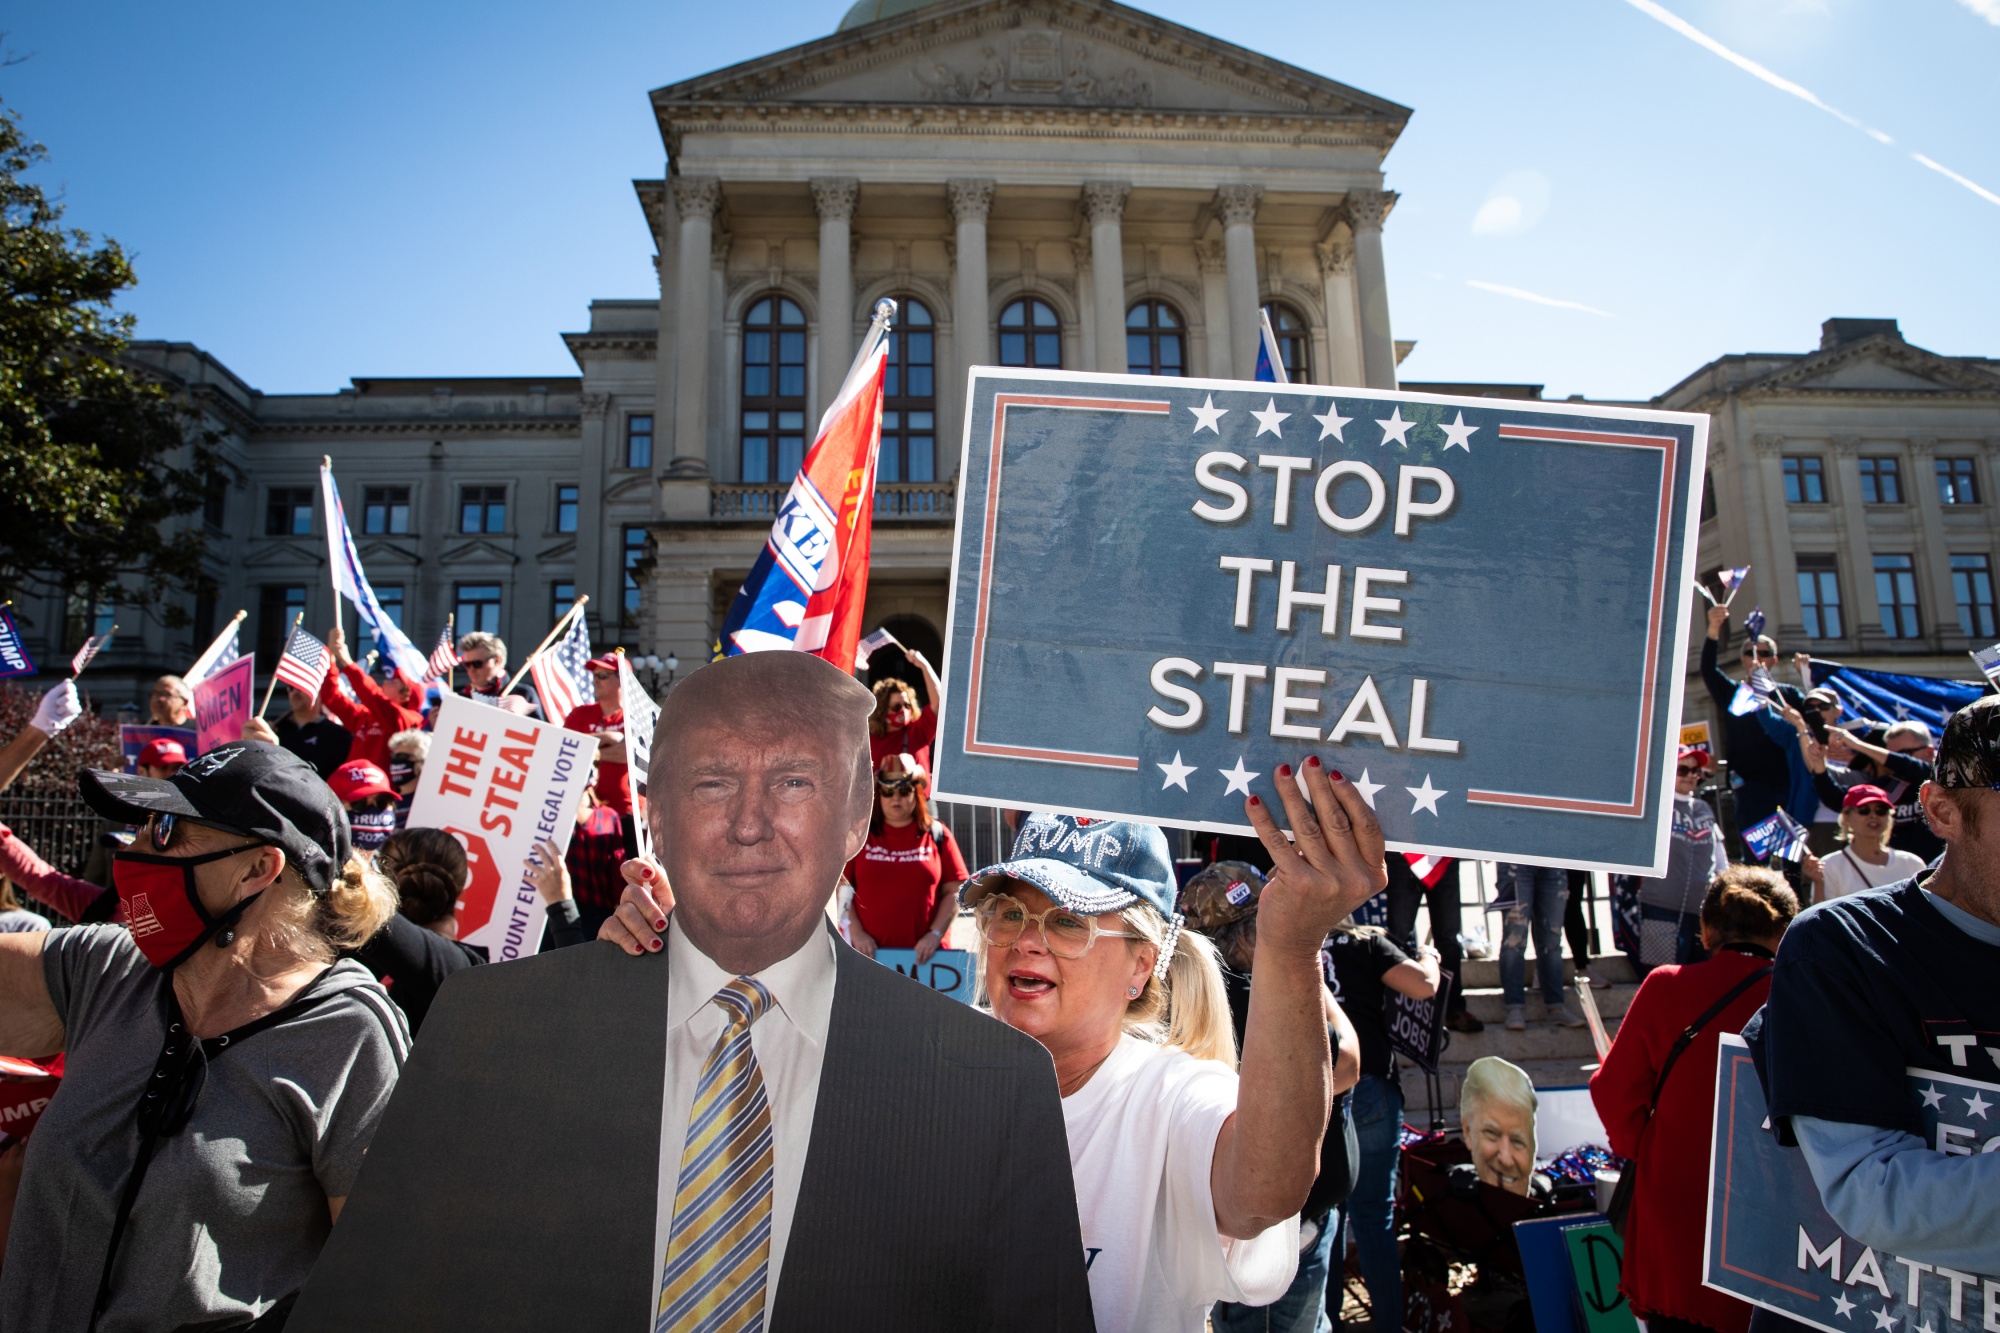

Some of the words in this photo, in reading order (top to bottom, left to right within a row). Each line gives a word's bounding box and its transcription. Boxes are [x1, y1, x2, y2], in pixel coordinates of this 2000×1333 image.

[1191, 451, 1455, 535] STOP
[1219, 556, 1408, 640] THE
[197, 682, 241, 733] OMEN
[1146, 657, 1460, 753] STEAL
[438, 726, 488, 797] THE
[480, 727, 541, 838] STEAL
[500, 906, 530, 962] OUNT
[534, 789, 565, 842] LEGAL
[551, 737, 580, 782] VOTE
[1391, 1012, 1430, 1056] JOBS!
[0, 1097, 50, 1122] MP
